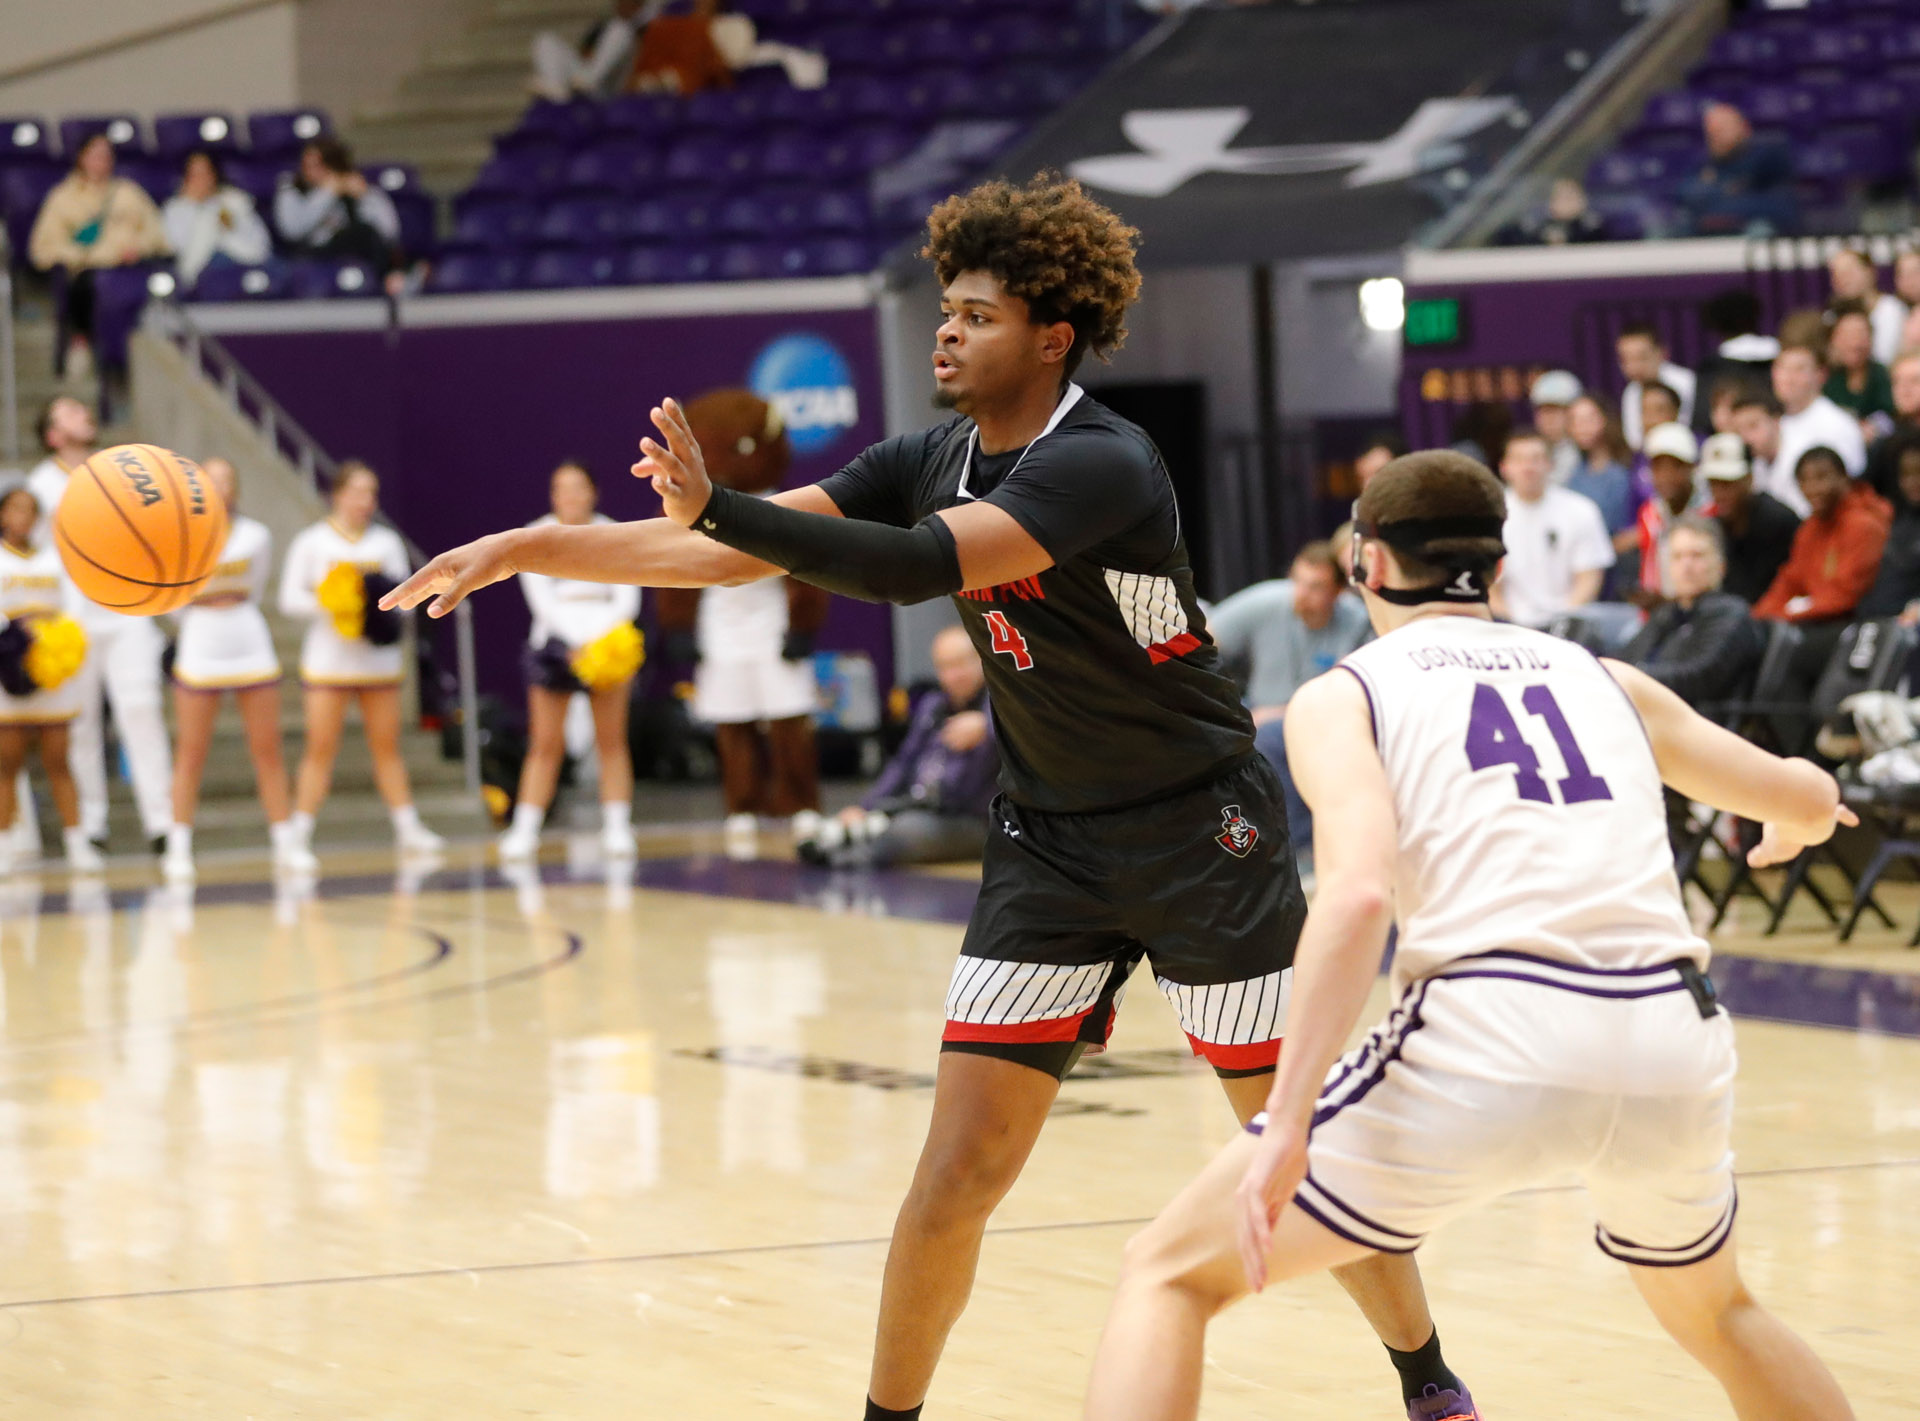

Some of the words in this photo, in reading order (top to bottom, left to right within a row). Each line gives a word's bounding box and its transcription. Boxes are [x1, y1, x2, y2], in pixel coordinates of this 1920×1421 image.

[112, 450, 164, 507] NCAA
[982, 610, 1034, 671] 4
[1464, 682, 1614, 805] 41
